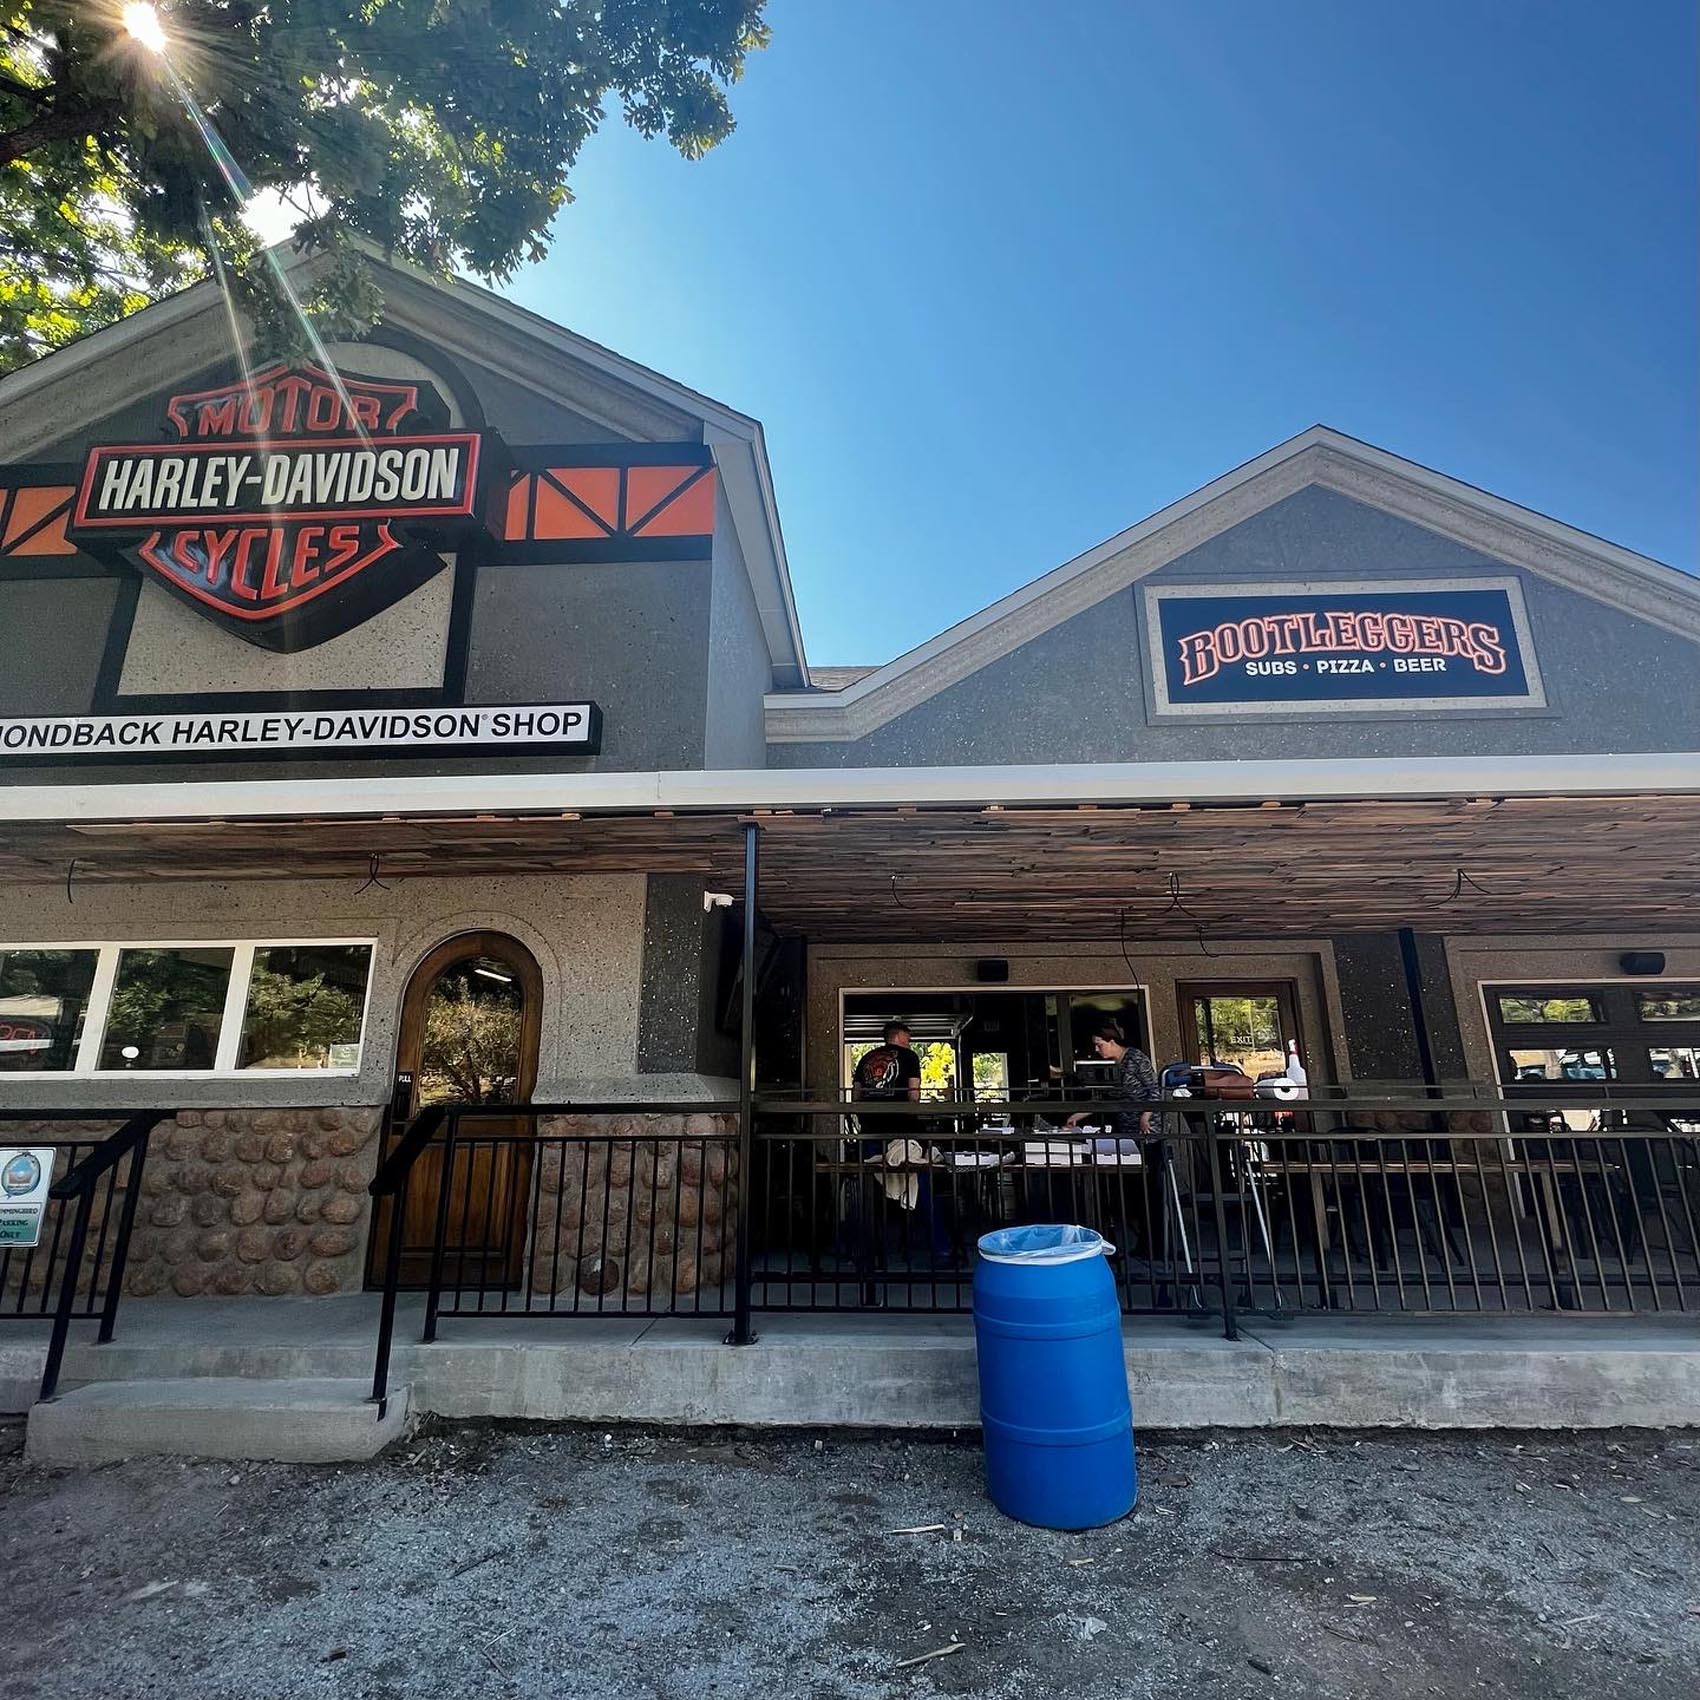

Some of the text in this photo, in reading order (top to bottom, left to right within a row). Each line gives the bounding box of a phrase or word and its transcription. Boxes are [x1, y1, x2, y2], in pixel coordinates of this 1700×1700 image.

[199, 377, 380, 435] MOTOR
[99, 447, 460, 511] HARLEY-DAVIDSON
[172, 525, 360, 600] CYCLES
[1179, 611, 1507, 686] BOOTLEGGERS
[1245, 657, 1447, 676] SUBS PIZZA BEER
[0, 721, 163, 748] ONDBACK
[491, 711, 582, 737] SHOP
